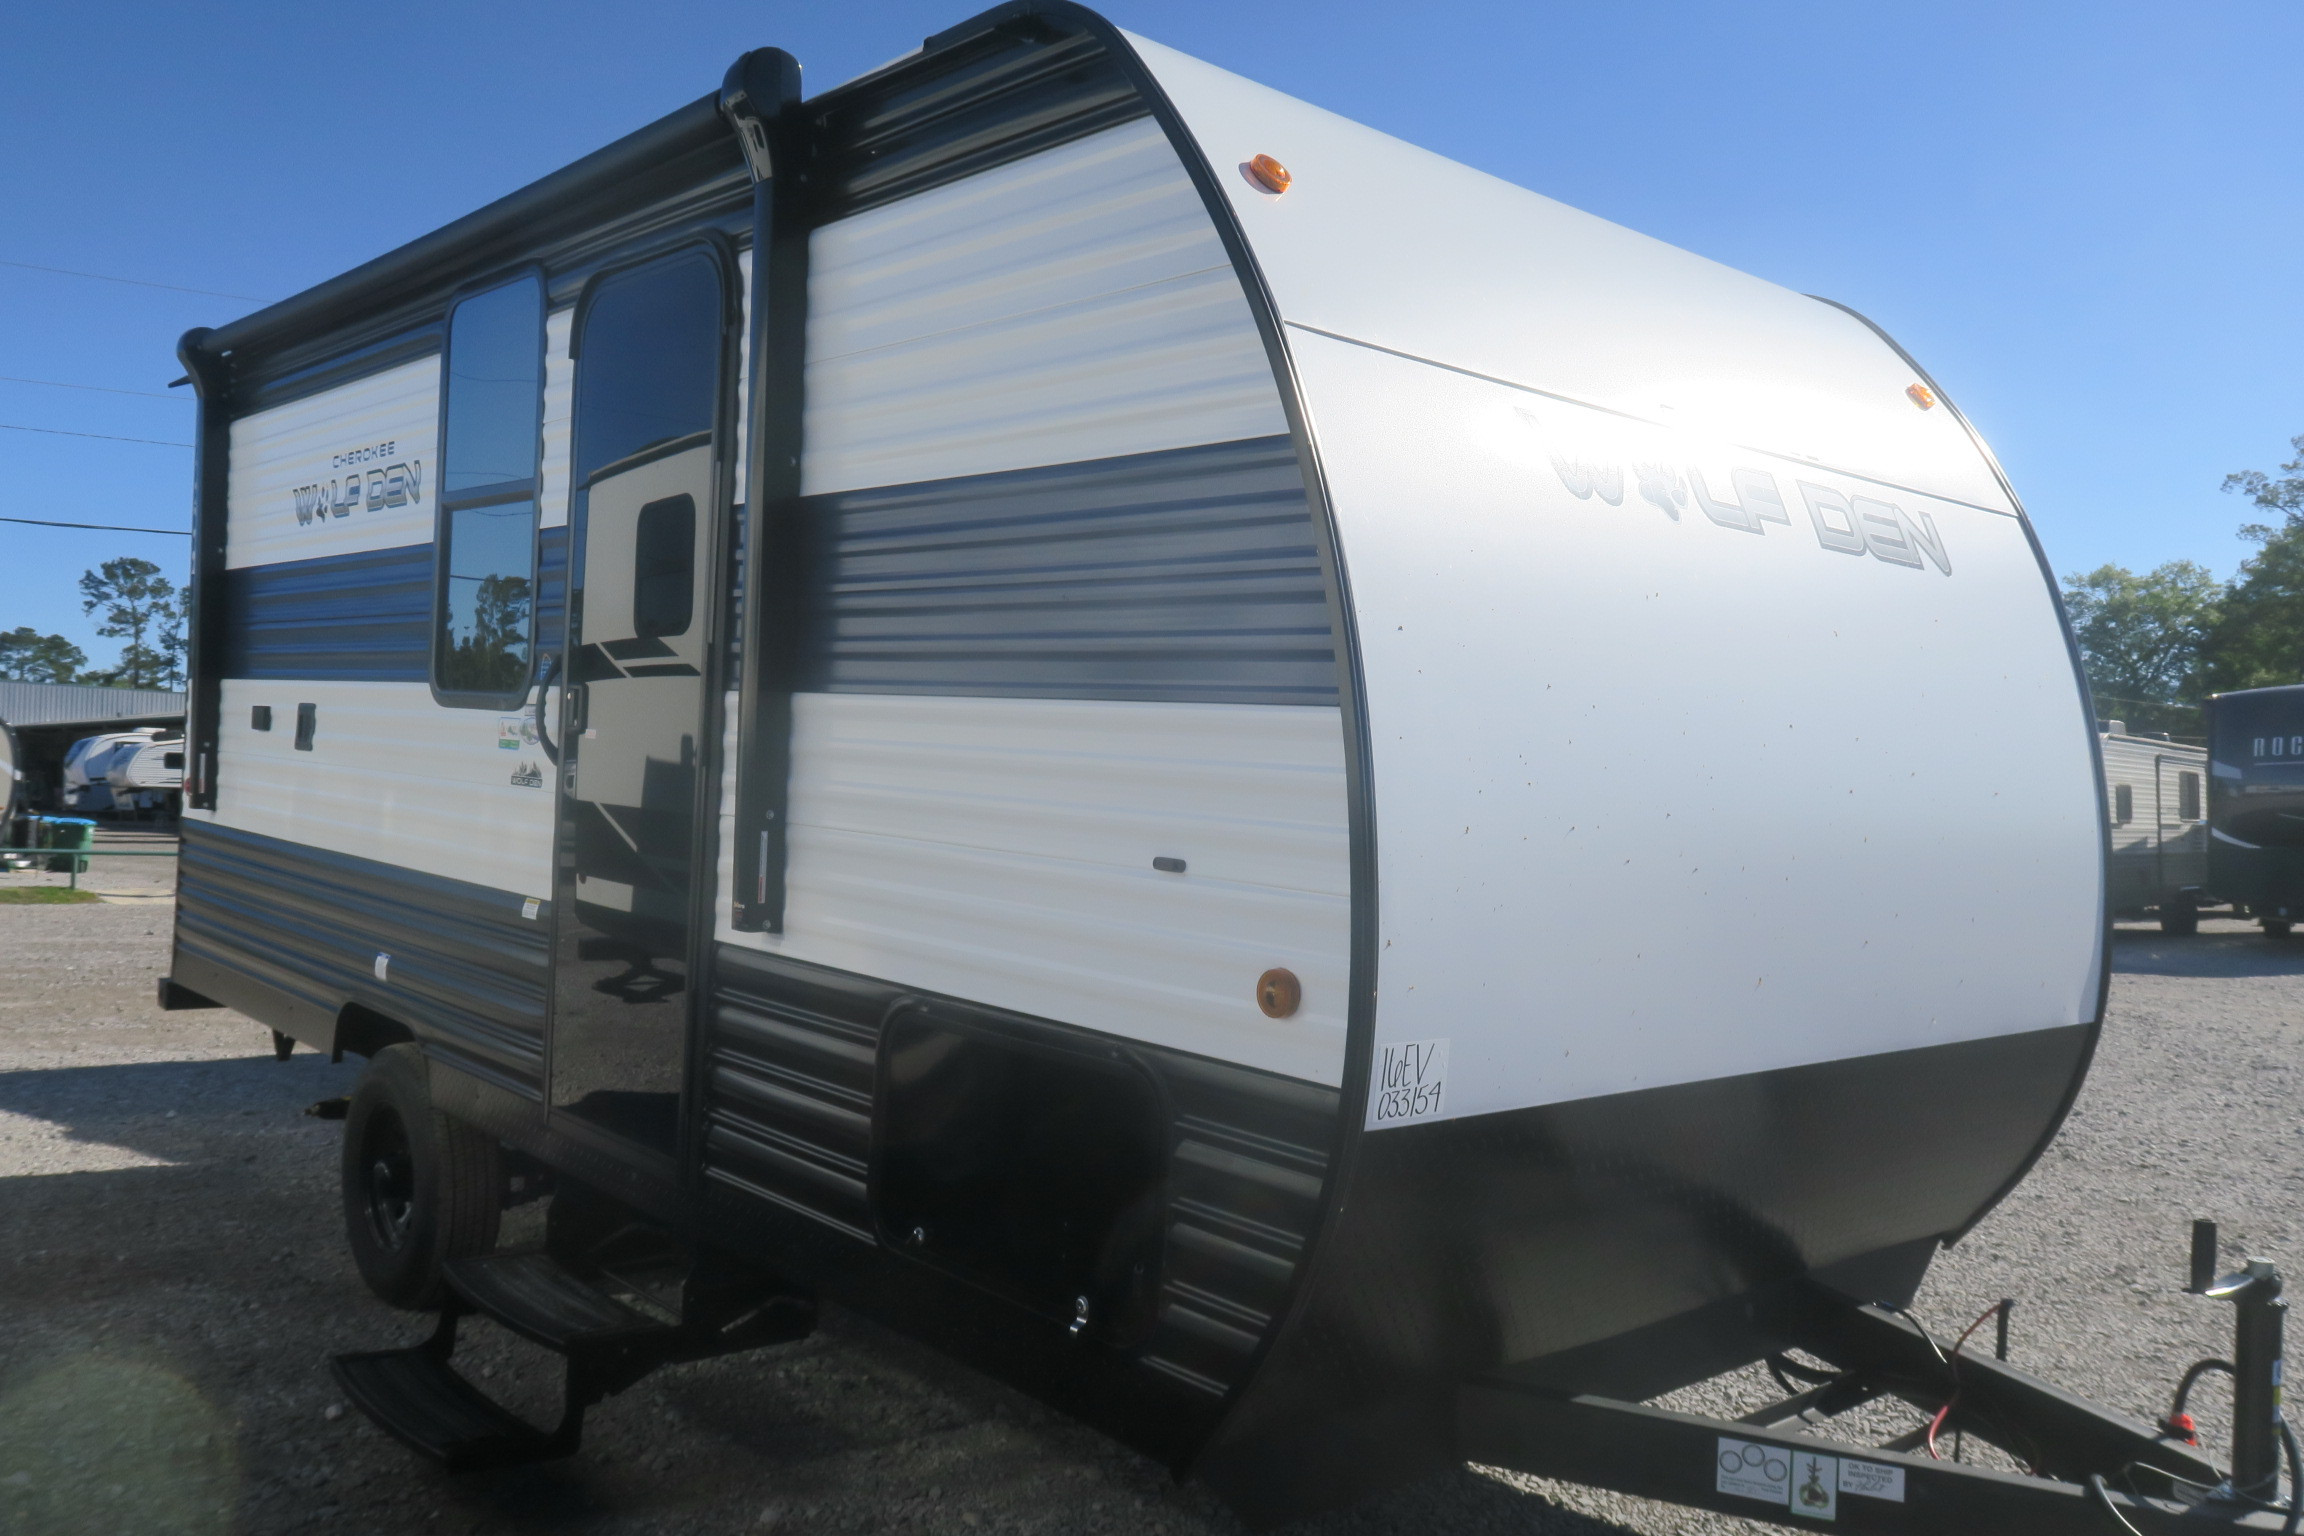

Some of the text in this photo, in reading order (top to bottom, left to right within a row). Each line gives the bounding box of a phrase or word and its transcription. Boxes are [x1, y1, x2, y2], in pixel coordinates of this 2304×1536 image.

[332, 441, 395, 468] CHEROKEE
[366, 459, 421, 512] DEN
[1795, 478, 1953, 577] DEN
[1377, 1081, 1441, 1121] 033154
[1847, 1469, 1893, 1484] INSPECTED
[1848, 1462, 1860, 1471] OK
[1862, 1464, 1873, 1472] TO
